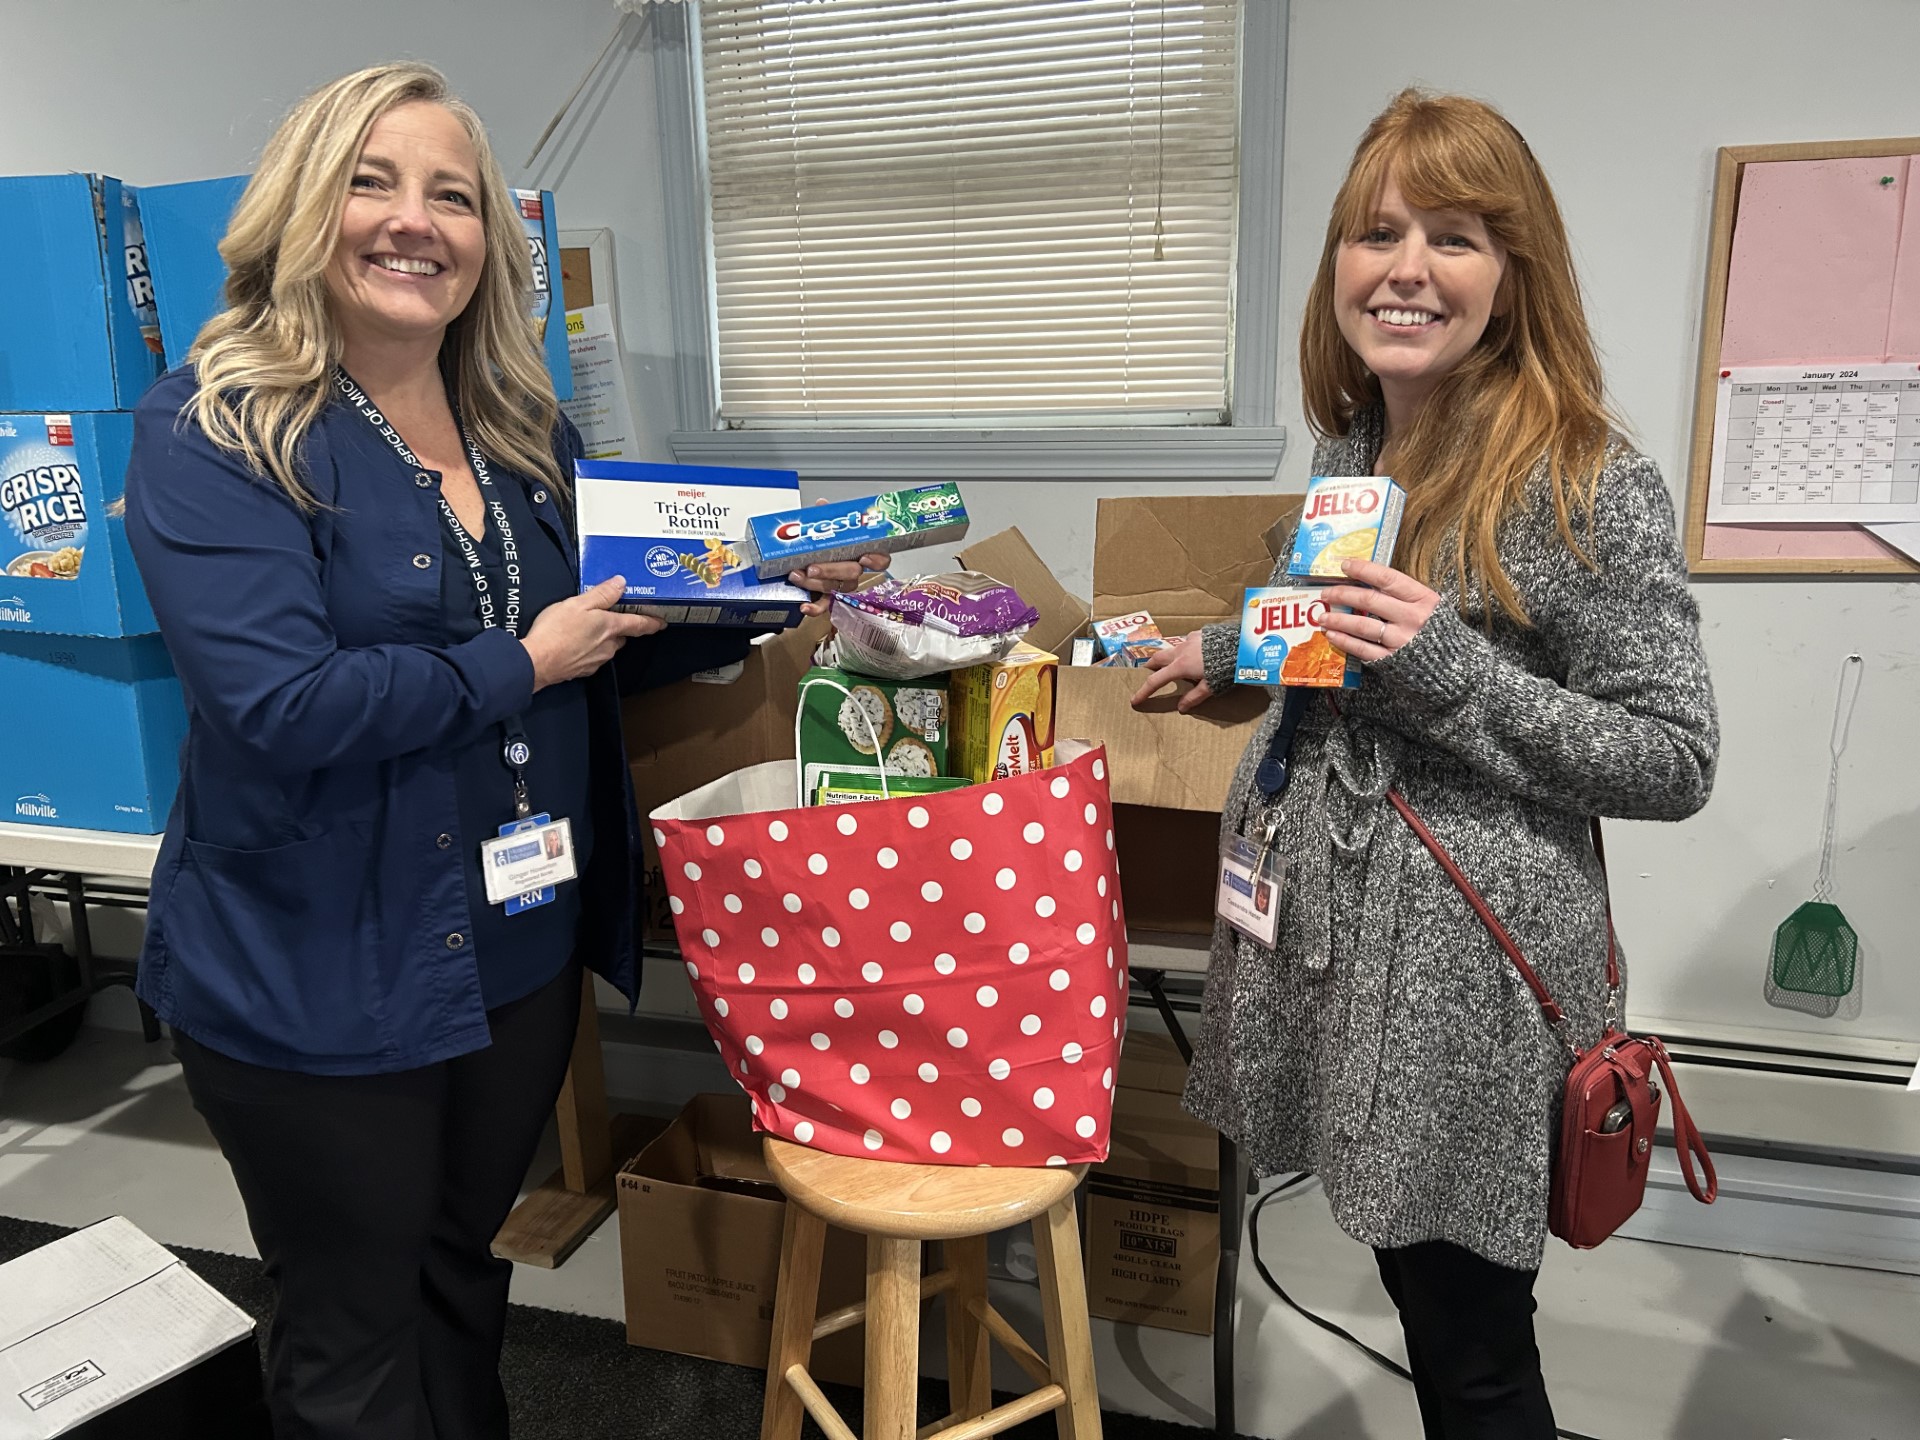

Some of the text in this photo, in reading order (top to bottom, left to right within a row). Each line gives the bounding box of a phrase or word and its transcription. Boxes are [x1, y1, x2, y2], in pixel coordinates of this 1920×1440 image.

[1802, 370, 1859, 380] January 2024
[361, 407, 384, 426] OF
[677, 489, 705, 499] meijer
[654, 501, 730, 517] Tri-Color
[908, 494, 960, 513] scope
[18, 492, 87, 534] RICE
[669, 515, 720, 530] Rotini
[775, 511, 861, 541] Crest
[437, 499, 481, 569] MICHIGAN
[489, 501, 518, 561] HOSPICE
[506, 564, 520, 585] OF
[655, 553, 668, 562] NO
[473, 571, 488, 592] OF
[633, 586, 656, 595] PRODUCT
[1261, 596, 1286, 605] orange
[925, 599, 939, 614] &
[938, 603, 979, 623] Onion
[1262, 644, 1282, 652] SUGAR
[826, 792, 858, 800] Nutrition
[15, 802, 57, 818] Millville
[519, 887, 543, 907] RN
[621, 1177, 639, 1191] 8-64
[1128, 1209, 1170, 1226] HDPE
[1113, 1219, 1185, 1238] PRODUCE BAGS
[1150, 1259, 1182, 1271] CLEAR
[665, 1268, 758, 1293] FRUIT PATCH APPLE JUICE
[1111, 1268, 1183, 1288] HIGH CLARITY
[1105, 1296, 1123, 1305] FOOD
[1171, 1307, 1188, 1316] SAFE
